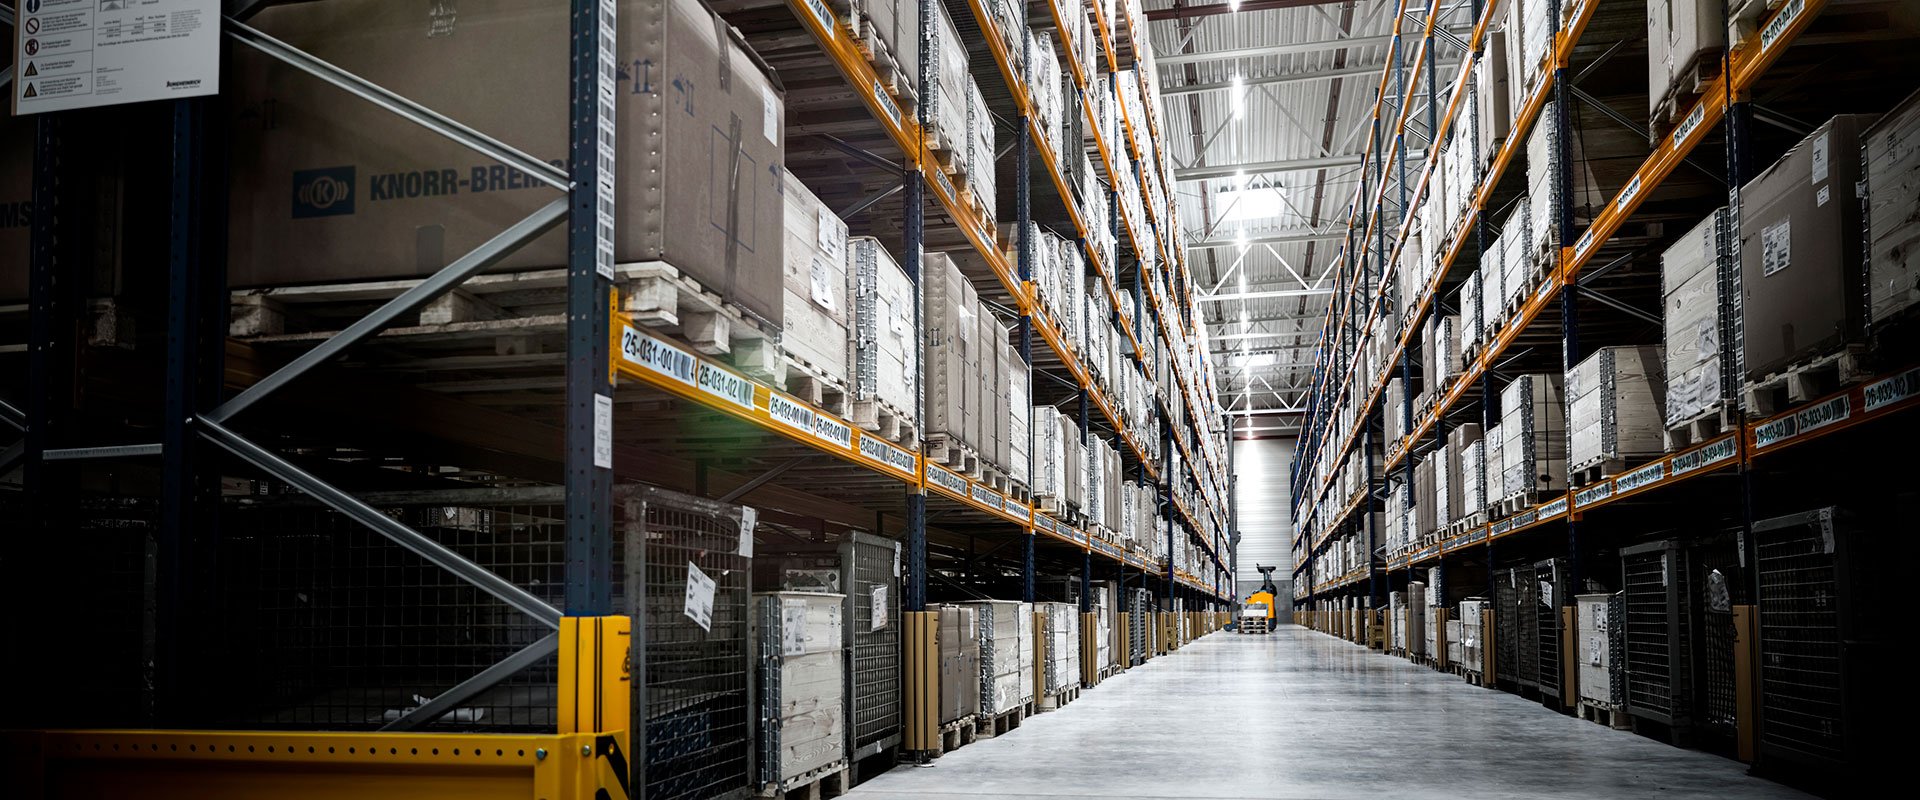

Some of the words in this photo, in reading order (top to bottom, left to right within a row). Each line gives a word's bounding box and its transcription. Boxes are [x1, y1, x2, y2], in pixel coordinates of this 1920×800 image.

[625, 332, 673, 371] 25-031-00
[699, 365, 738, 398] 25-031-02
[1866, 377, 1906, 407] 26-032-02
[770, 397, 800, 424] 25-032-00
[1800, 404, 1831, 429] 26-033-00
